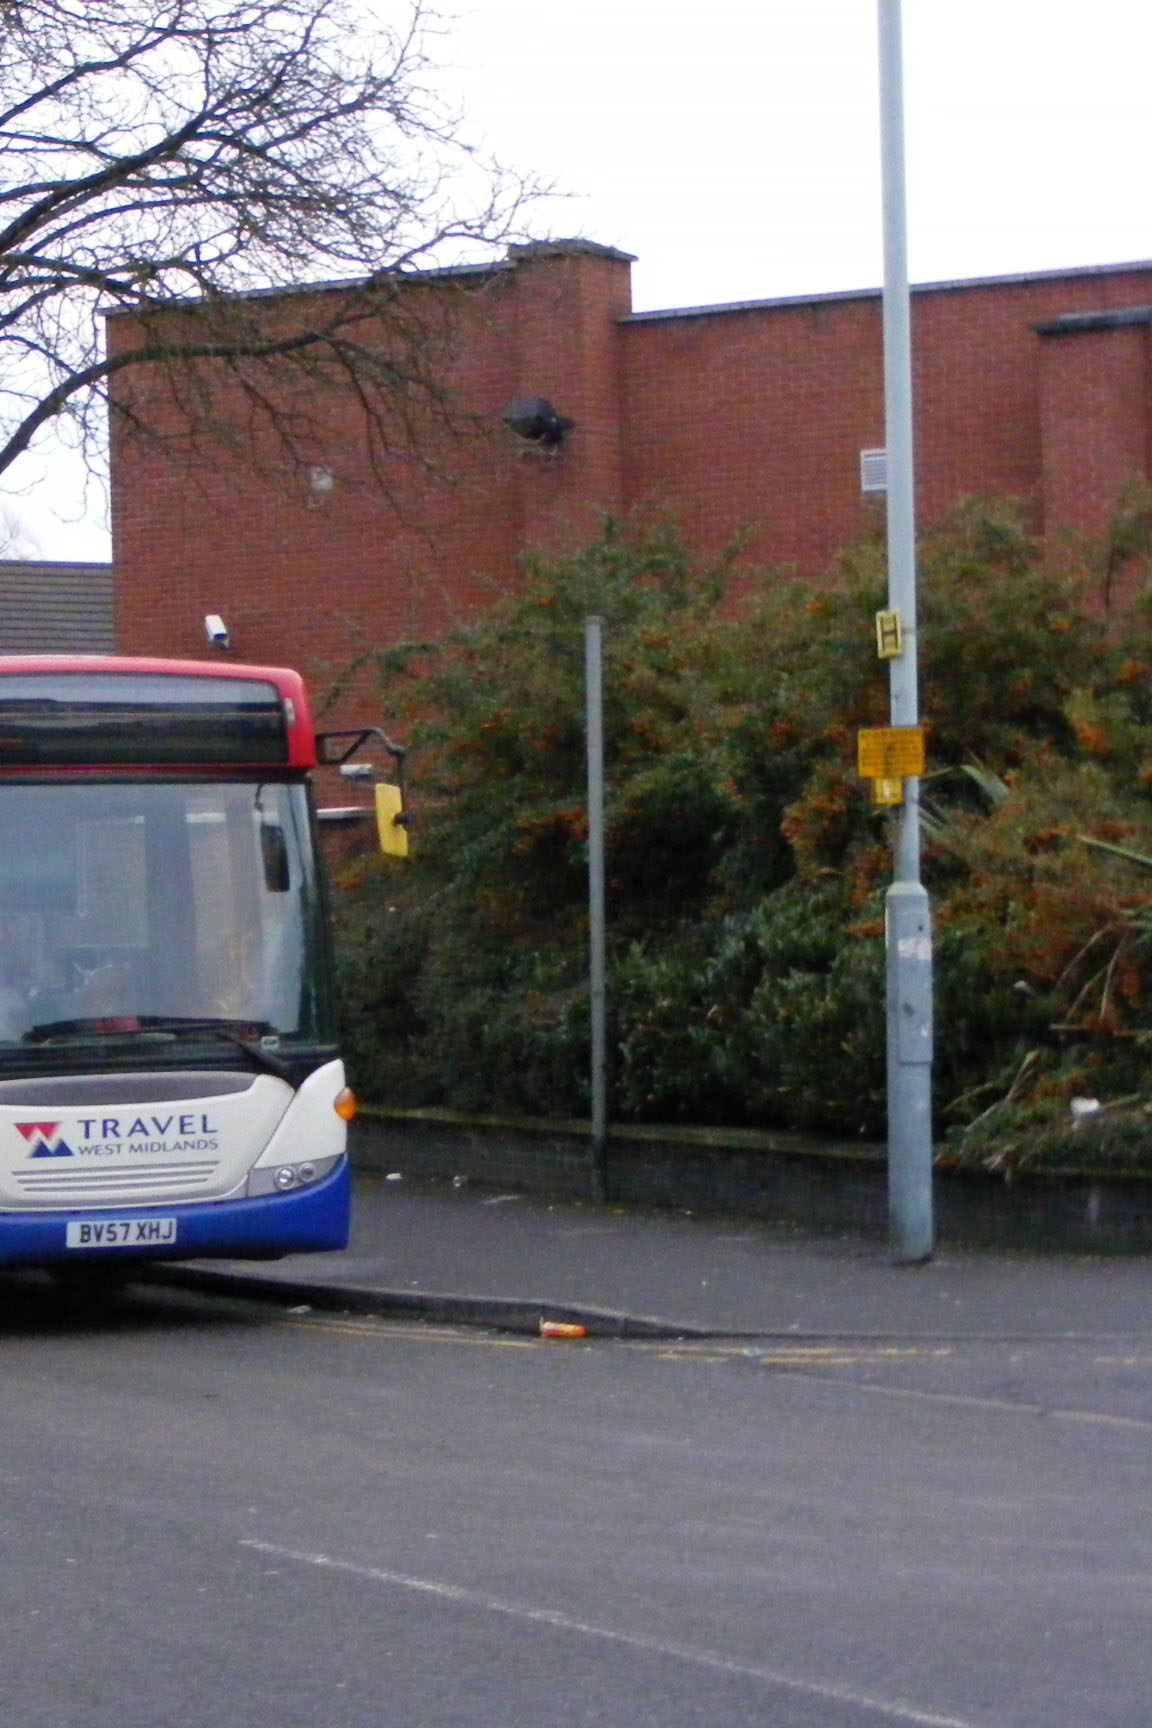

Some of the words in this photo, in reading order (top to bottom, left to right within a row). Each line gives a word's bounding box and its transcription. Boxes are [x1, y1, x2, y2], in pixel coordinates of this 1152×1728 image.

[881, 615, 898, 654] H
[78, 1114, 218, 1140] TRAVEL
[78, 1143, 123, 1157] WEST
[128, 1138, 219, 1154] MIDLANDS
[79, 1222, 131, 1244] BV57
[135, 1221, 175, 1241] XHJ
